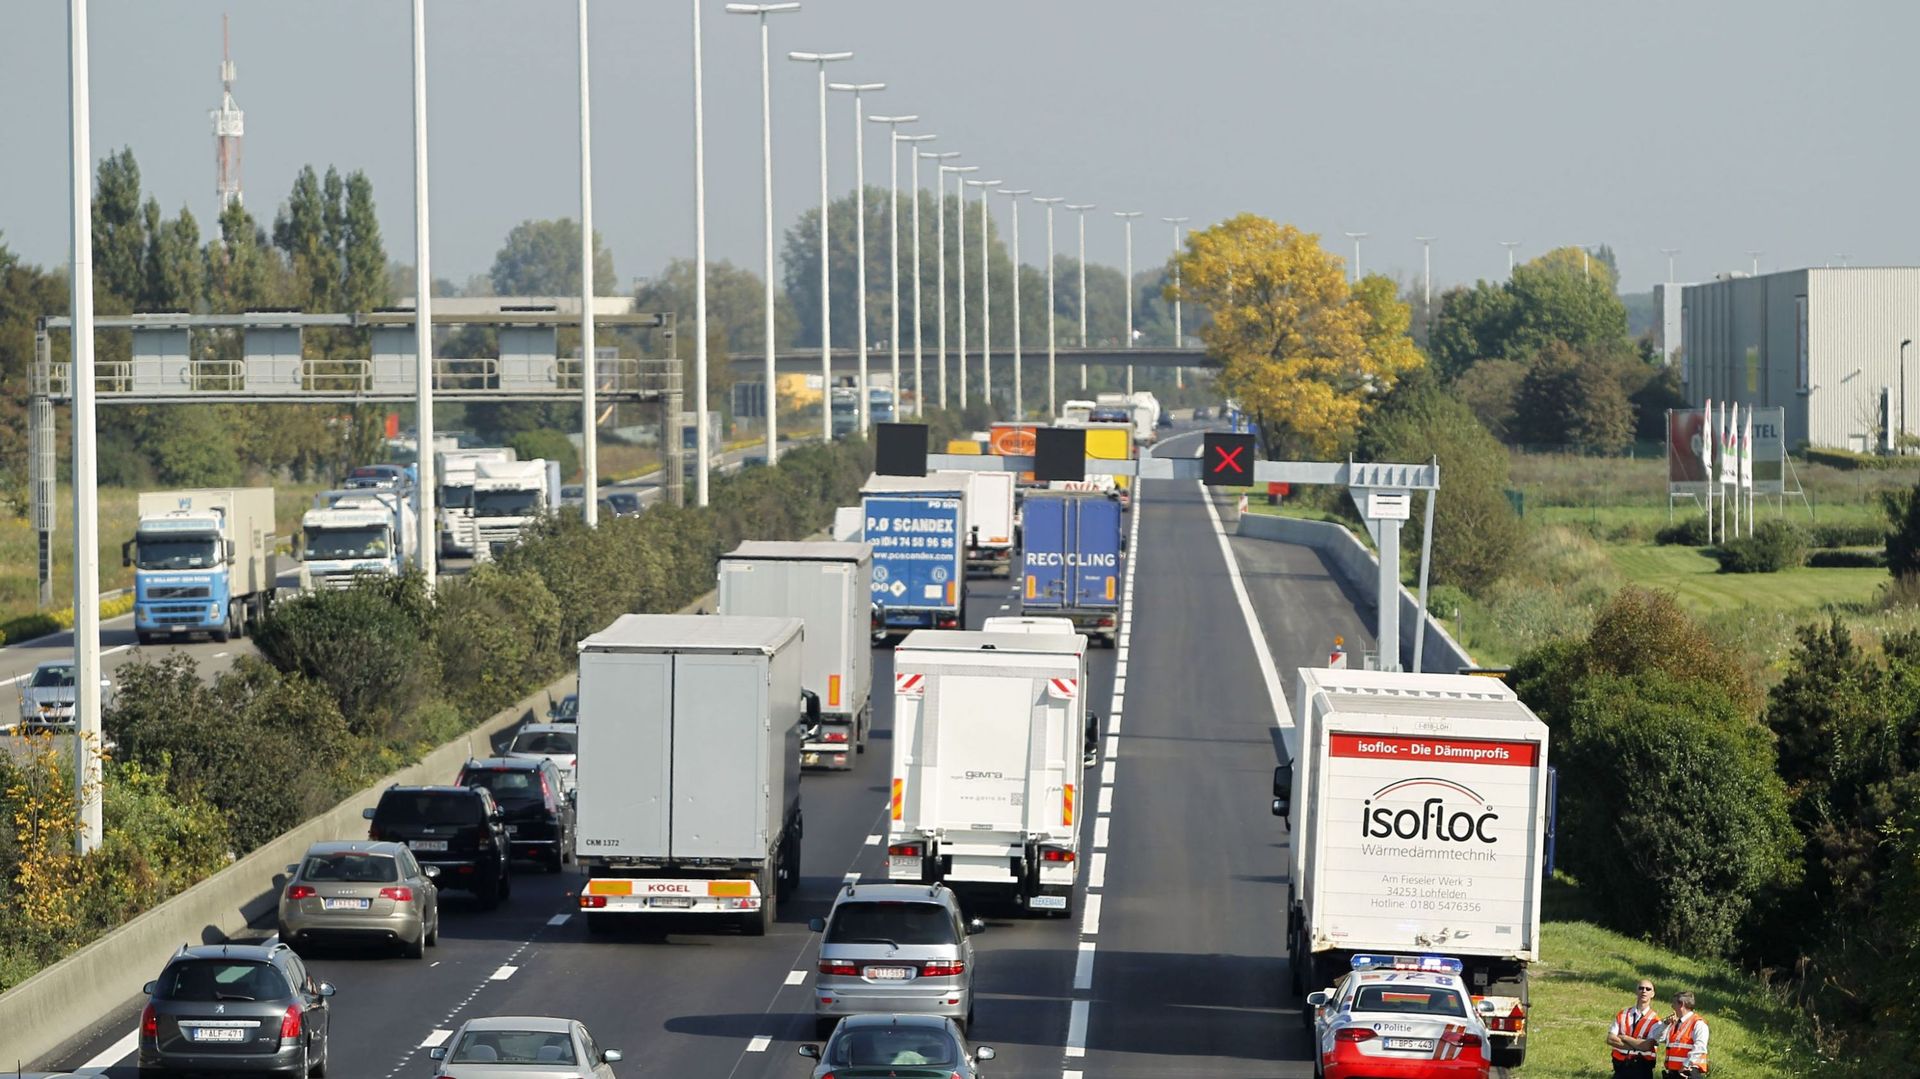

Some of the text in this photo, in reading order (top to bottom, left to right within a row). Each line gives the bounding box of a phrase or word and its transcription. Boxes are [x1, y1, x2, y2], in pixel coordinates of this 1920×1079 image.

[893, 517, 954, 533] SCANDEX
[872, 551, 954, 561] ww.poscandex.com
[1026, 552, 1116, 567] RECYCLING
[1357, 740, 1398, 754] isofloc
[1411, 743, 1431, 756] Die
[1434, 743, 1510, 761] Dämmprofis
[965, 770, 1003, 780] gavra
[1362, 798, 1498, 844] isofloc
[586, 839, 620, 847] CKM 1372
[1361, 843, 1497, 862] Wärmedämmtechnik
[1381, 874, 1473, 888] Am Fieseler Werk 3
[1387, 887, 1467, 900] 34253 Lohfelden
[1371, 898, 1481, 912] Hotline: 0180 5476356
[200, 1028, 243, 1038] 1-ALF-471
[1384, 1024, 1412, 1033] Politie
[1390, 1039, 1433, 1049] 1-BPS-443
